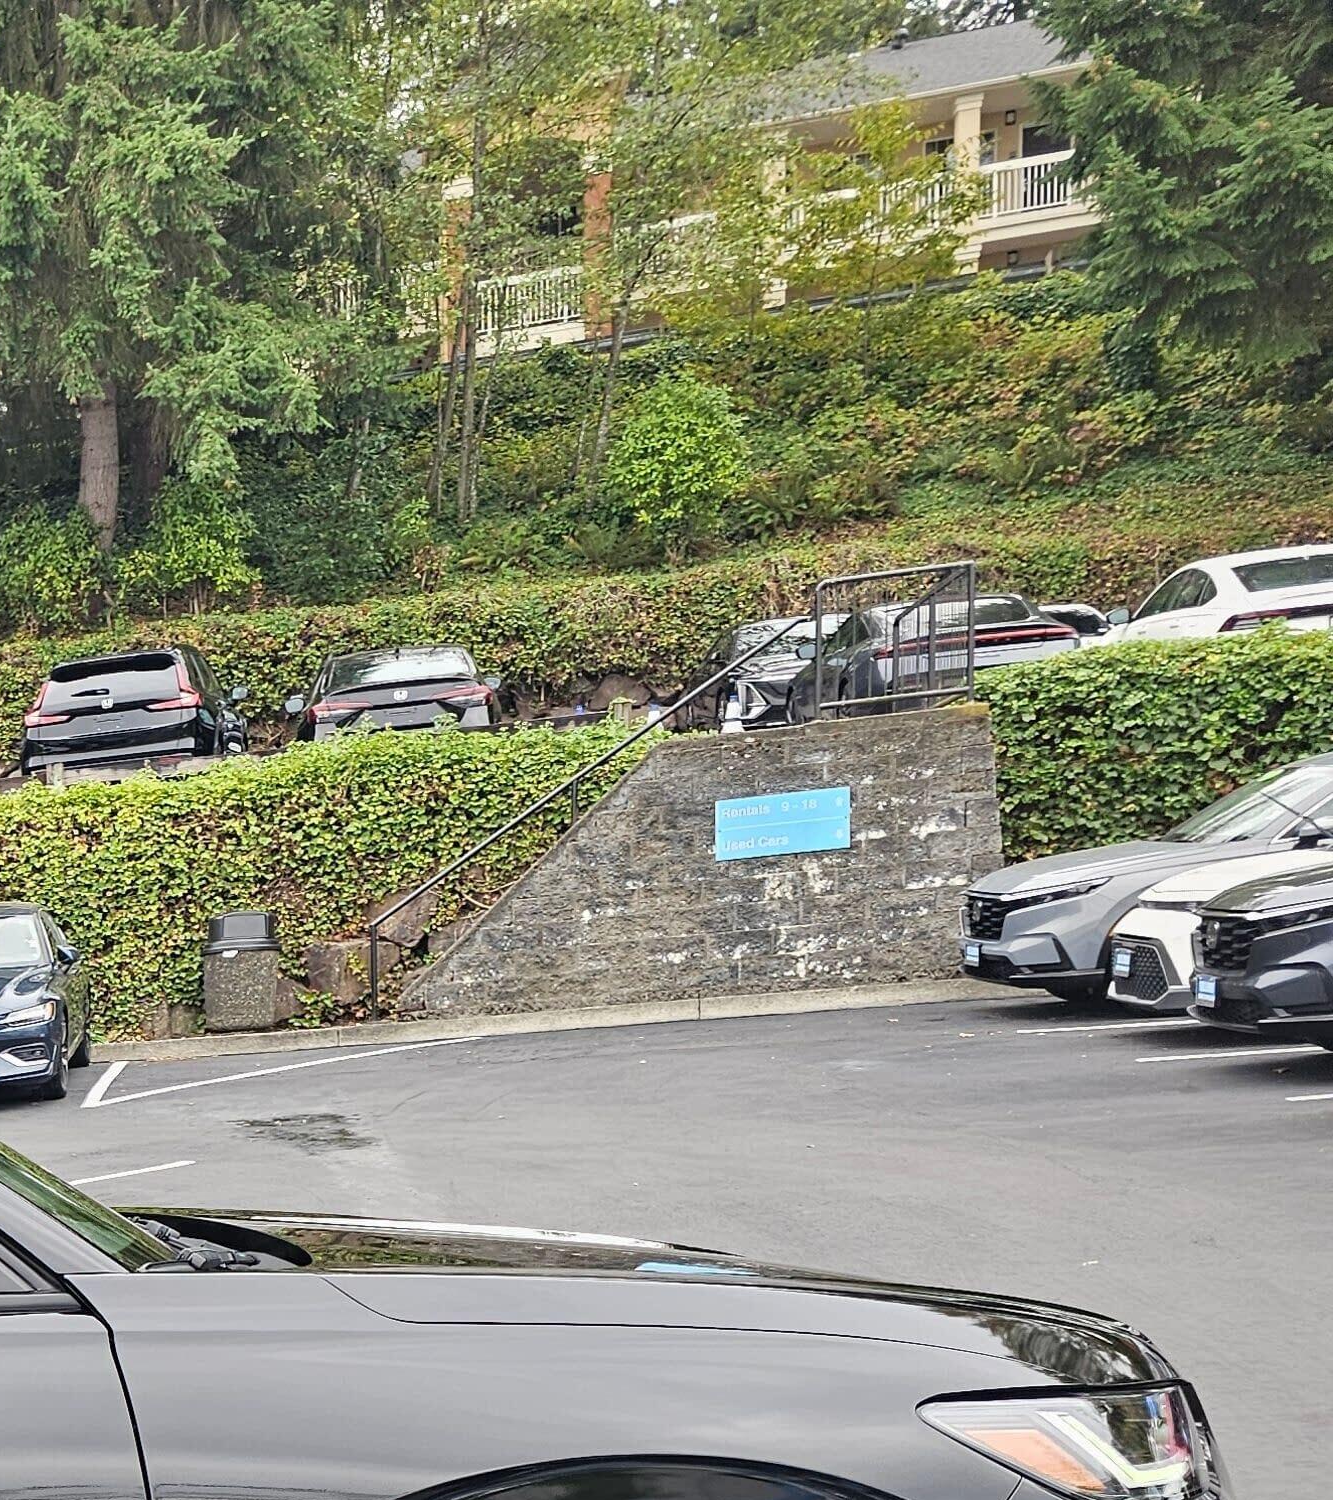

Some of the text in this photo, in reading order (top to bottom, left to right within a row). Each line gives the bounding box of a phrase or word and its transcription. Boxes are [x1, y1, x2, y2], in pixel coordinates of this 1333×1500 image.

[722, 804, 771, 818] Rentals
[780, 801, 790, 812] 9
[802, 799, 818, 810] 18
[724, 835, 789, 851] Used Cars
